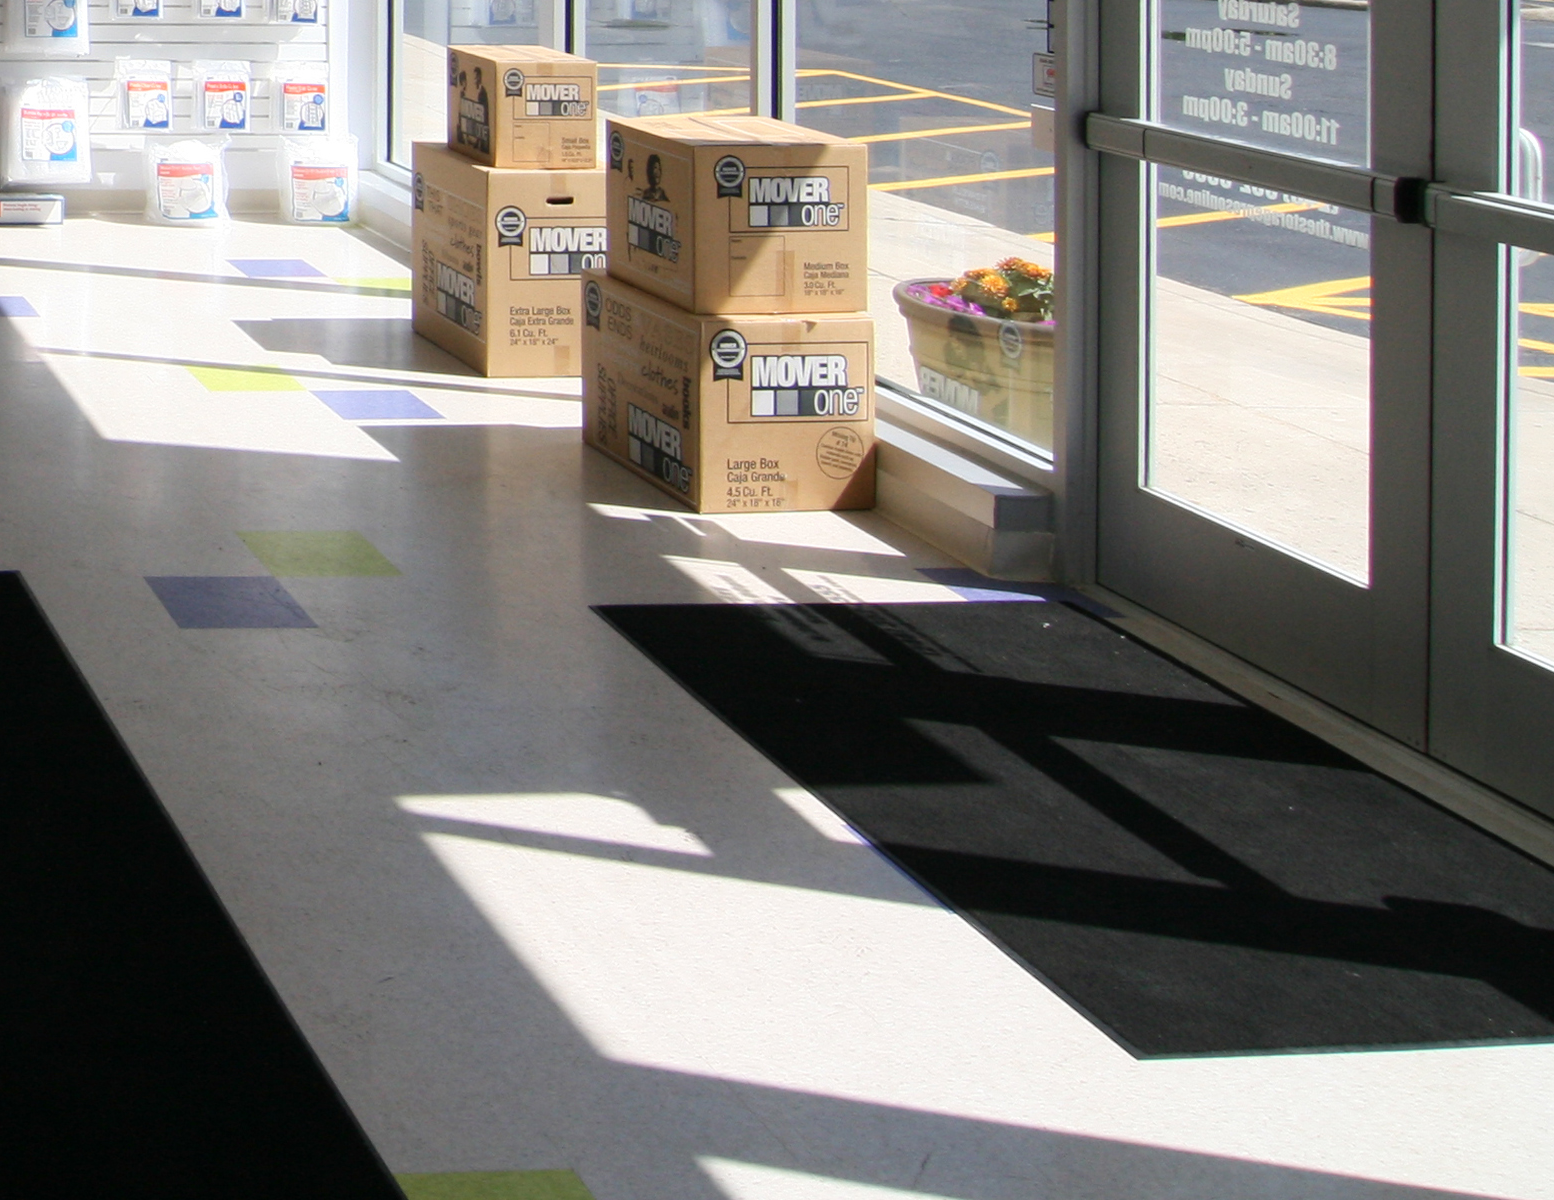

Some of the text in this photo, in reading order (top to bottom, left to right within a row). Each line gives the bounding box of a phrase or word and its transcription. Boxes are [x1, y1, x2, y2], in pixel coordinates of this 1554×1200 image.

[526, 83, 580, 101] MOVER
[560, 101, 588, 117] one
[748, 175, 830, 204] MOVER
[627, 195, 674, 238] MOVER
[801, 204, 841, 227] one
[529, 226, 607, 253] MOVER
[655, 235, 682, 263] one
[581, 253, 607, 269] on
[803, 261, 849, 271] Medium Box
[436, 260, 475, 308] MOVER
[803, 271, 818, 280] Caja
[509, 306, 571, 318] Extra Large Box
[605, 297, 632, 322] ODDS
[509, 317, 574, 327] Caja Extra Grande
[509, 328, 548, 337] 6.1 Cu. Ft.
[607, 316, 633, 340] ENDS
[639, 334, 689, 373] heirlooms
[641, 360, 679, 396] clothes
[750, 354, 848, 388] MOVER
[682, 376, 692, 430] books
[813, 388, 860, 417] one
[627, 402, 682, 463] MOVER
[662, 456, 691, 492] one
[727, 457, 779, 472] Large Box
[727, 471, 786, 485] Caja Grande
[726, 486, 773, 497] 4.5 Cu. Ft.
